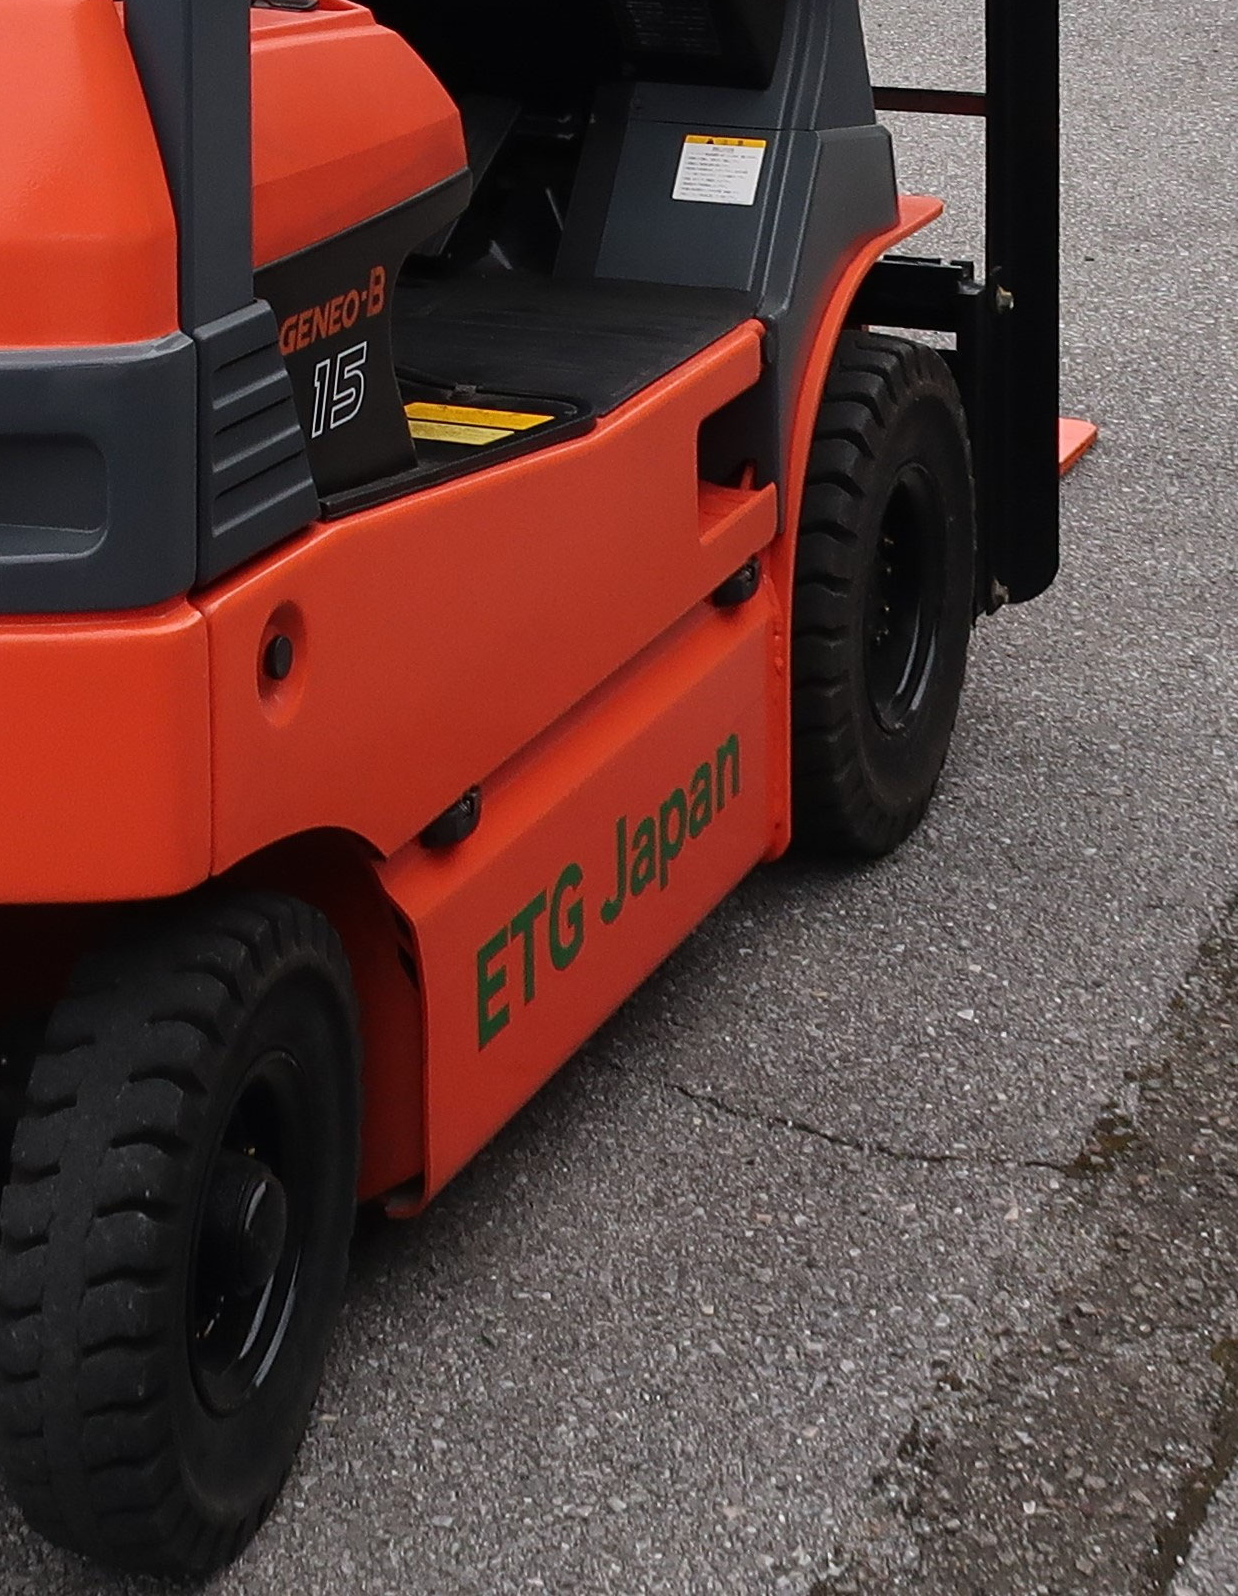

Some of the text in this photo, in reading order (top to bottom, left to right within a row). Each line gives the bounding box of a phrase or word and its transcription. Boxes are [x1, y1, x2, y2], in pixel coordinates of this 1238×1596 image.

[312, 341, 367, 438] 15
[476, 733, 740, 1052] ETG Japan
